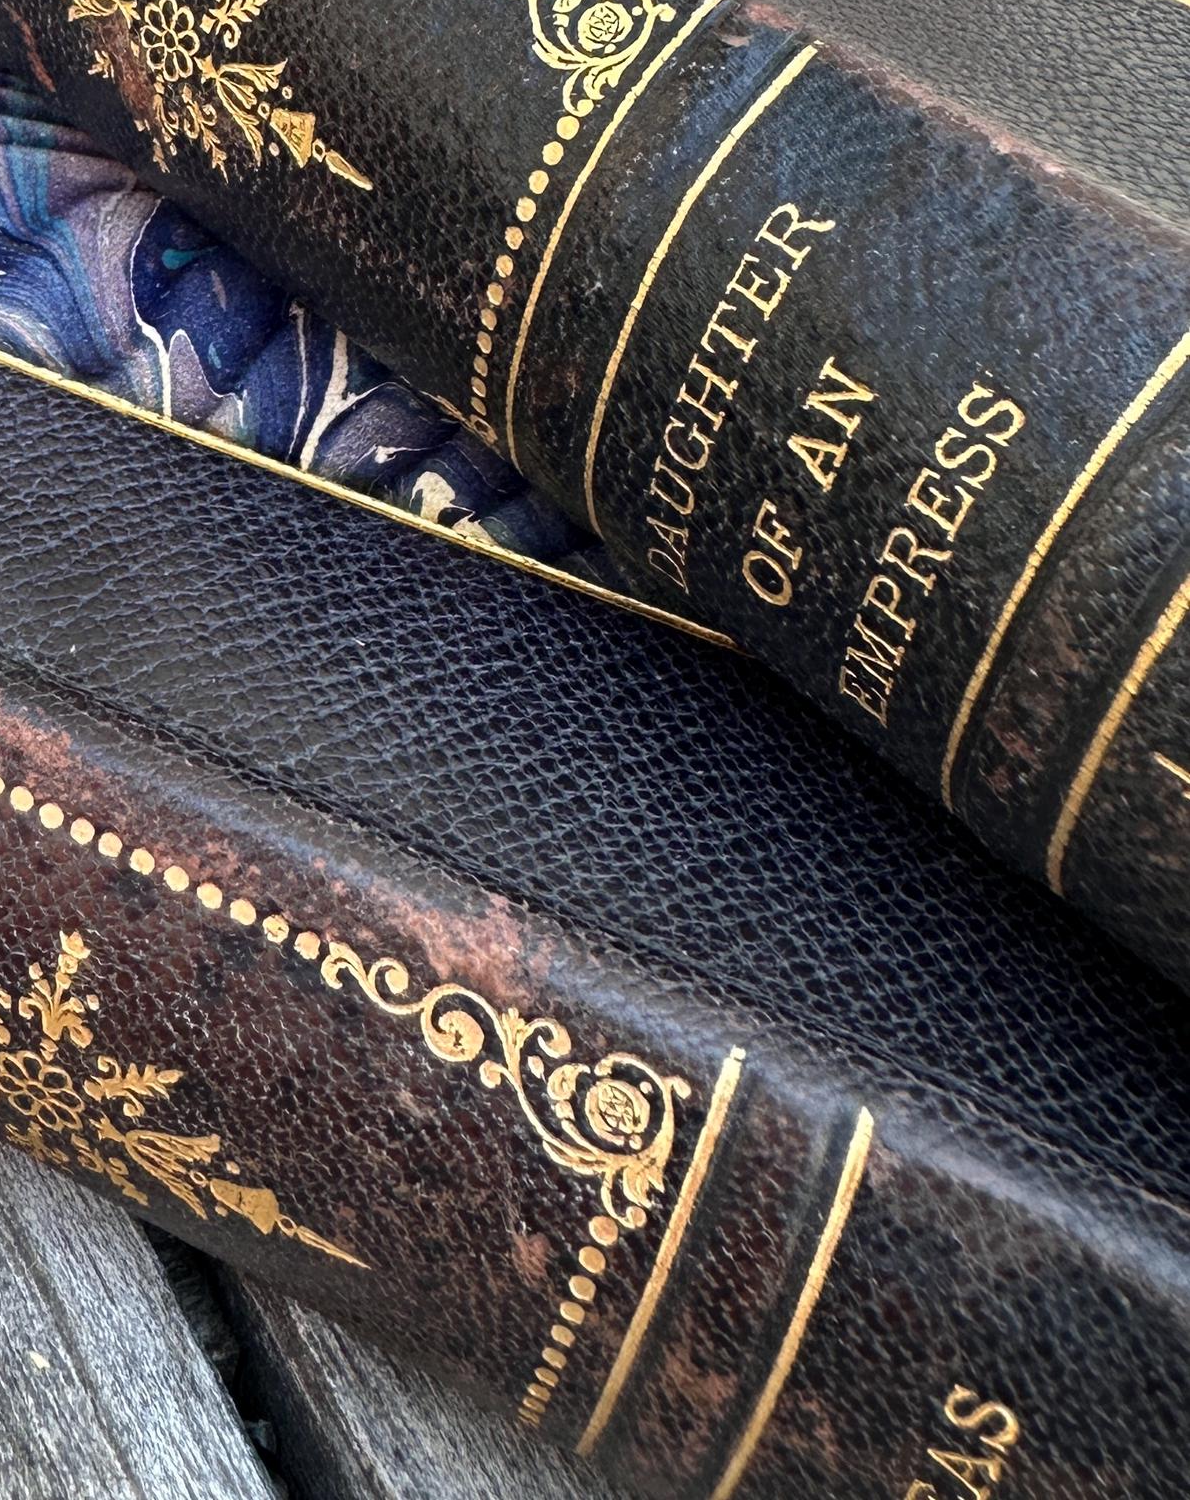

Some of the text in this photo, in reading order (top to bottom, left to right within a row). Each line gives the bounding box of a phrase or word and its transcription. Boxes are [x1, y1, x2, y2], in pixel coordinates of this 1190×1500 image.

[646, 202, 837, 595] DAUGHTER
[741, 357, 878, 607] OF AN
[838, 376, 1027, 729] EMPRESS
[903, 1383, 1021, 1500] AS
